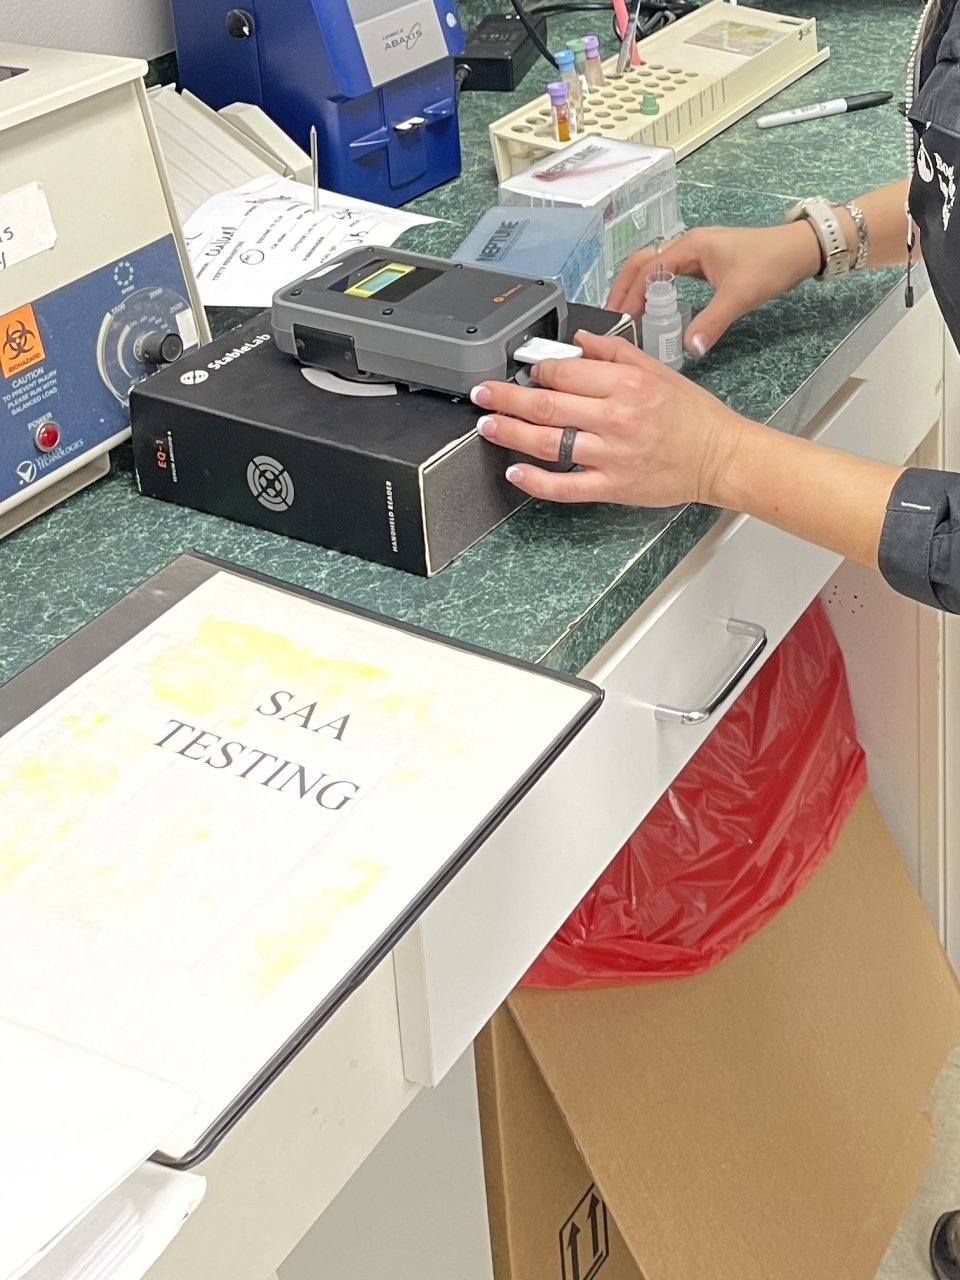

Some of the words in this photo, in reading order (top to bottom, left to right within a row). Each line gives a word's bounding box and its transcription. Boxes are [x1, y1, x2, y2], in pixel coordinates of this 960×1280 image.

[384, 29, 422, 51] ABAXIS
[475, 220, 520, 262] NEPTUNE
[207, 333, 271, 370] StableLab
[3, 394, 11, 402] TO
[12, 381, 37, 398] PREVENT
[37, 369, 57, 384] INJURY
[12, 366, 44, 388] CAUTION
[7, 395, 29, 409] PLEASE
[29, 386, 42, 398] RUN
[42, 379, 57, 390] WITH
[11, 396, 42, 416] BALANCED
[42, 386, 58, 399] LOAD
[27, 411, 53, 430] POWER
[155, 439, 167, 469] EQ-1
[385, 480, 394, 511] READER
[388, 511, 399, 553] HANDHELD
[255, 690, 350, 741] SAA
[152, 718, 361, 811] TESTING
